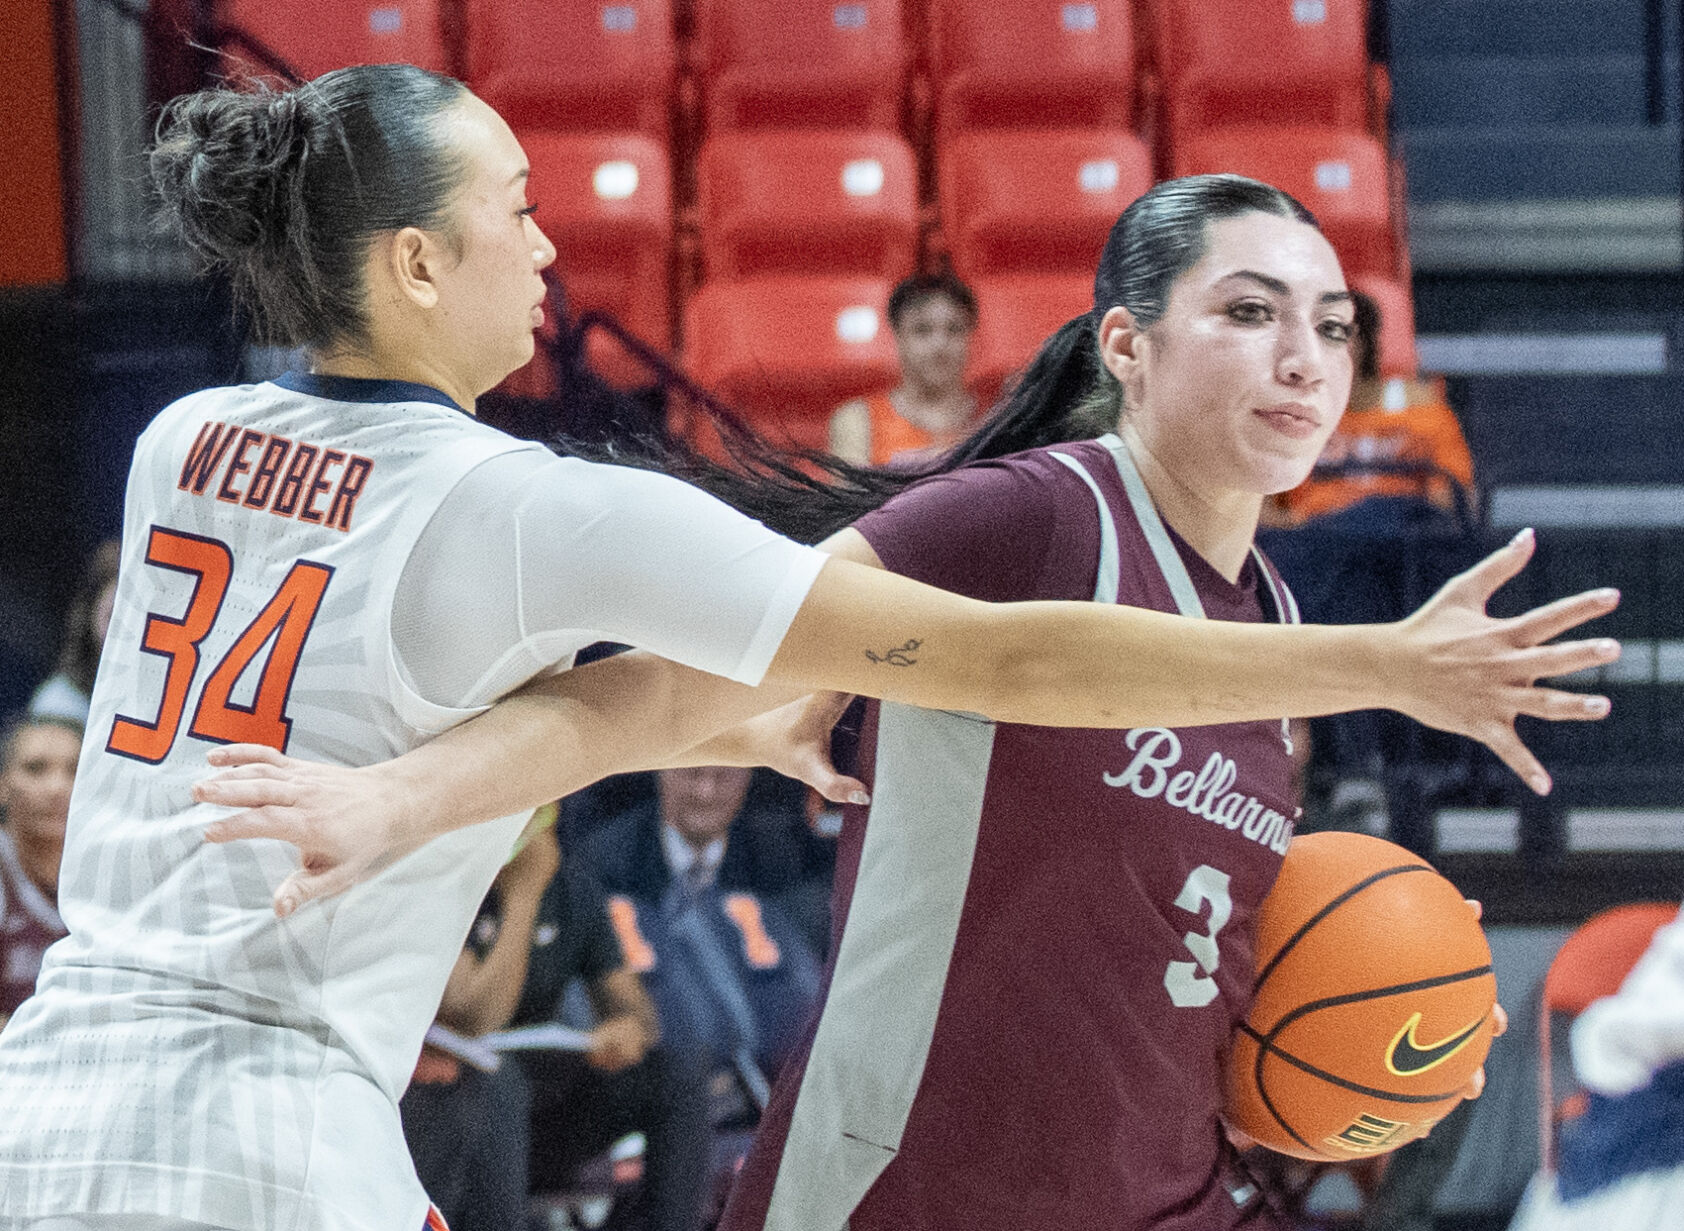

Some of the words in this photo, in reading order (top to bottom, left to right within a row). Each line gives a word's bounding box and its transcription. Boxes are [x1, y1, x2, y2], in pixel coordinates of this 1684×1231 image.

[177, 421, 374, 532] WEBBER
[105, 524, 336, 766] 34
[1164, 864, 1233, 1007] 3
